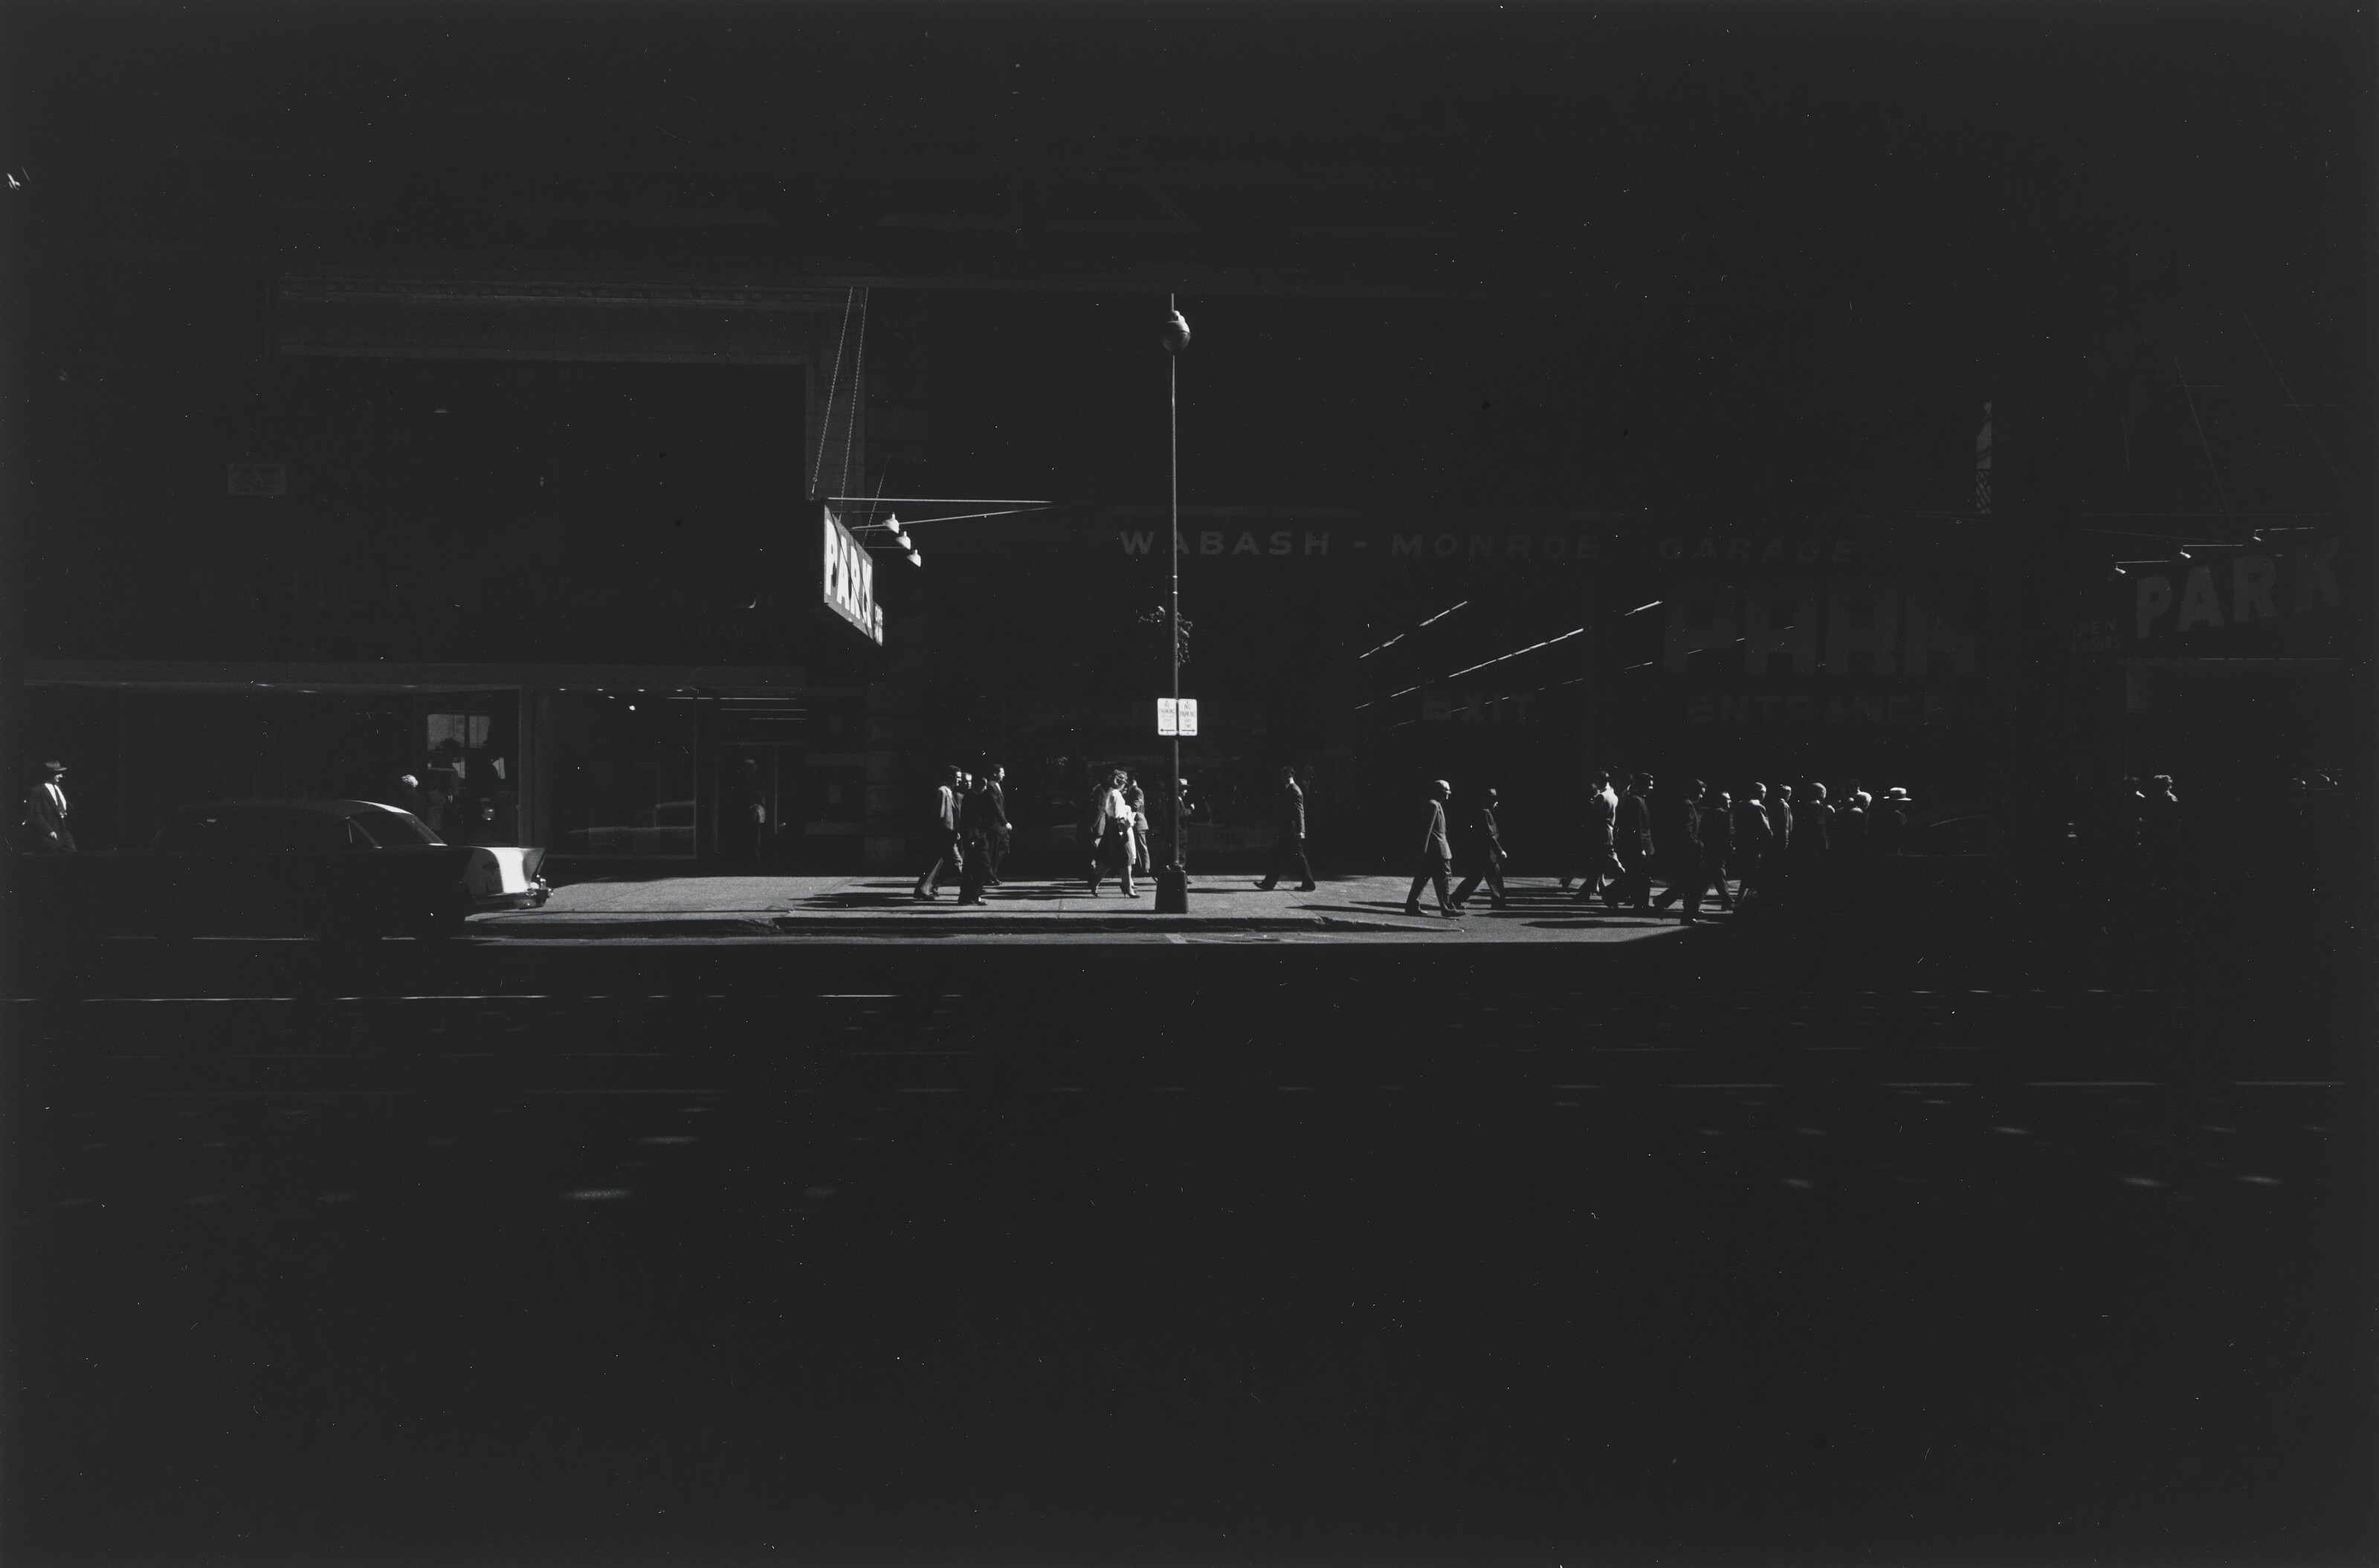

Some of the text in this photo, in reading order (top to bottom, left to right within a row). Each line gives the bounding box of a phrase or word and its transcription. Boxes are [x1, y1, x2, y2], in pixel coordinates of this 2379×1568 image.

[826, 519, 873, 630] PARK
[1119, 531, 1330, 555] WABASH
[1390, 532, 1601, 558] MONROE
[1658, 537, 1856, 564] GARAGE
[2135, 537, 2343, 639] PARK
[1662, 577, 1977, 674] PARK
[1421, 688, 1537, 723] EXIT
[1685, 694, 1952, 725] ENTRANCE
